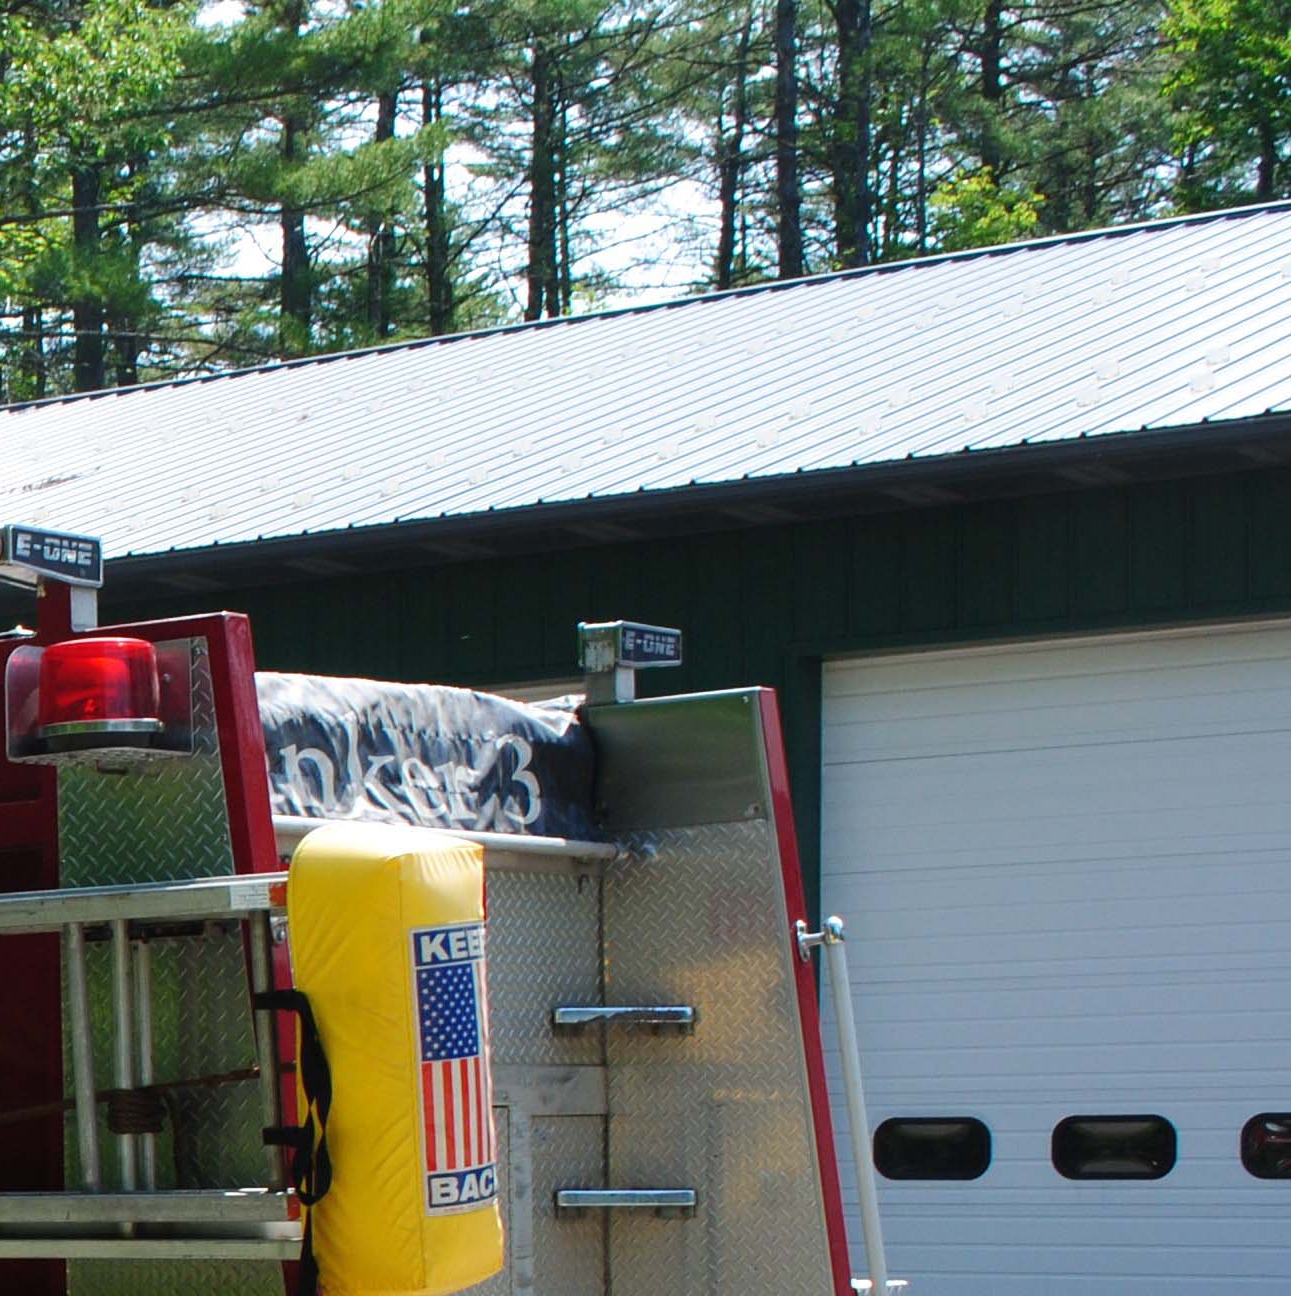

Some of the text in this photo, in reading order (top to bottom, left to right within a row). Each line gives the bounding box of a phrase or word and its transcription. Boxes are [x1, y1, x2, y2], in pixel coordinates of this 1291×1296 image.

[15, 531, 94, 566] E-ONE
[624, 629, 676, 656] E-ONE
[494, 732, 542, 826] 3
[430, 1166, 498, 1206] BAC
